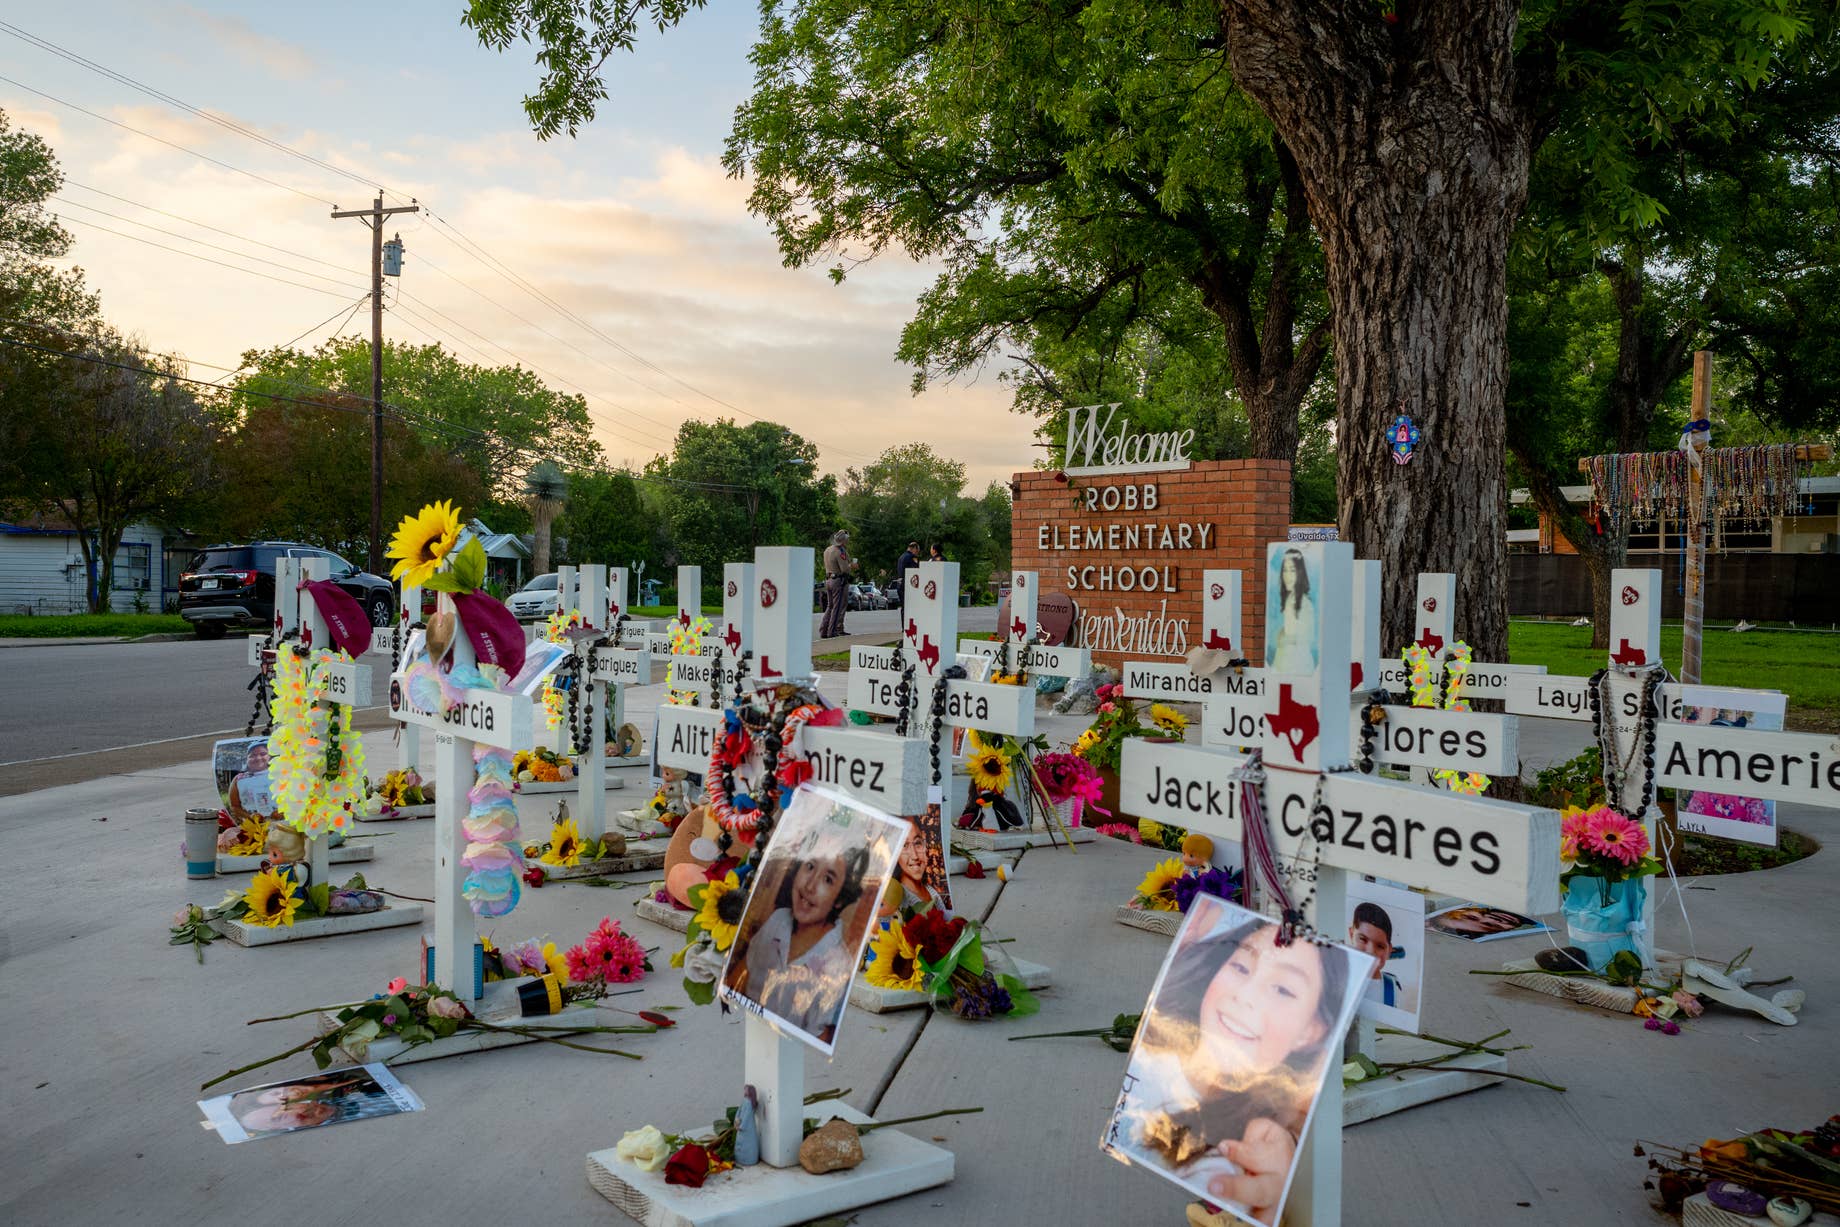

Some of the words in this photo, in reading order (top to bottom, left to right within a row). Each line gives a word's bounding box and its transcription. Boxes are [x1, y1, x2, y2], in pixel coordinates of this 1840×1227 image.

[1065, 402, 1195, 468] Welcome
[1086, 484, 1158, 511] ROBB
[1039, 523, 1212, 550] ELEMENTARY
[1067, 565, 1177, 593] SCHOOL
[595, 656, 638, 676] odriguez
[677, 663, 734, 684] Makena
[1130, 671, 1212, 693] Miranda
[1538, 686, 1588, 713] Layl
[1377, 720, 1487, 758] lores
[1146, 765, 1237, 820] Jacki
[1281, 793, 1500, 875] Cazares
